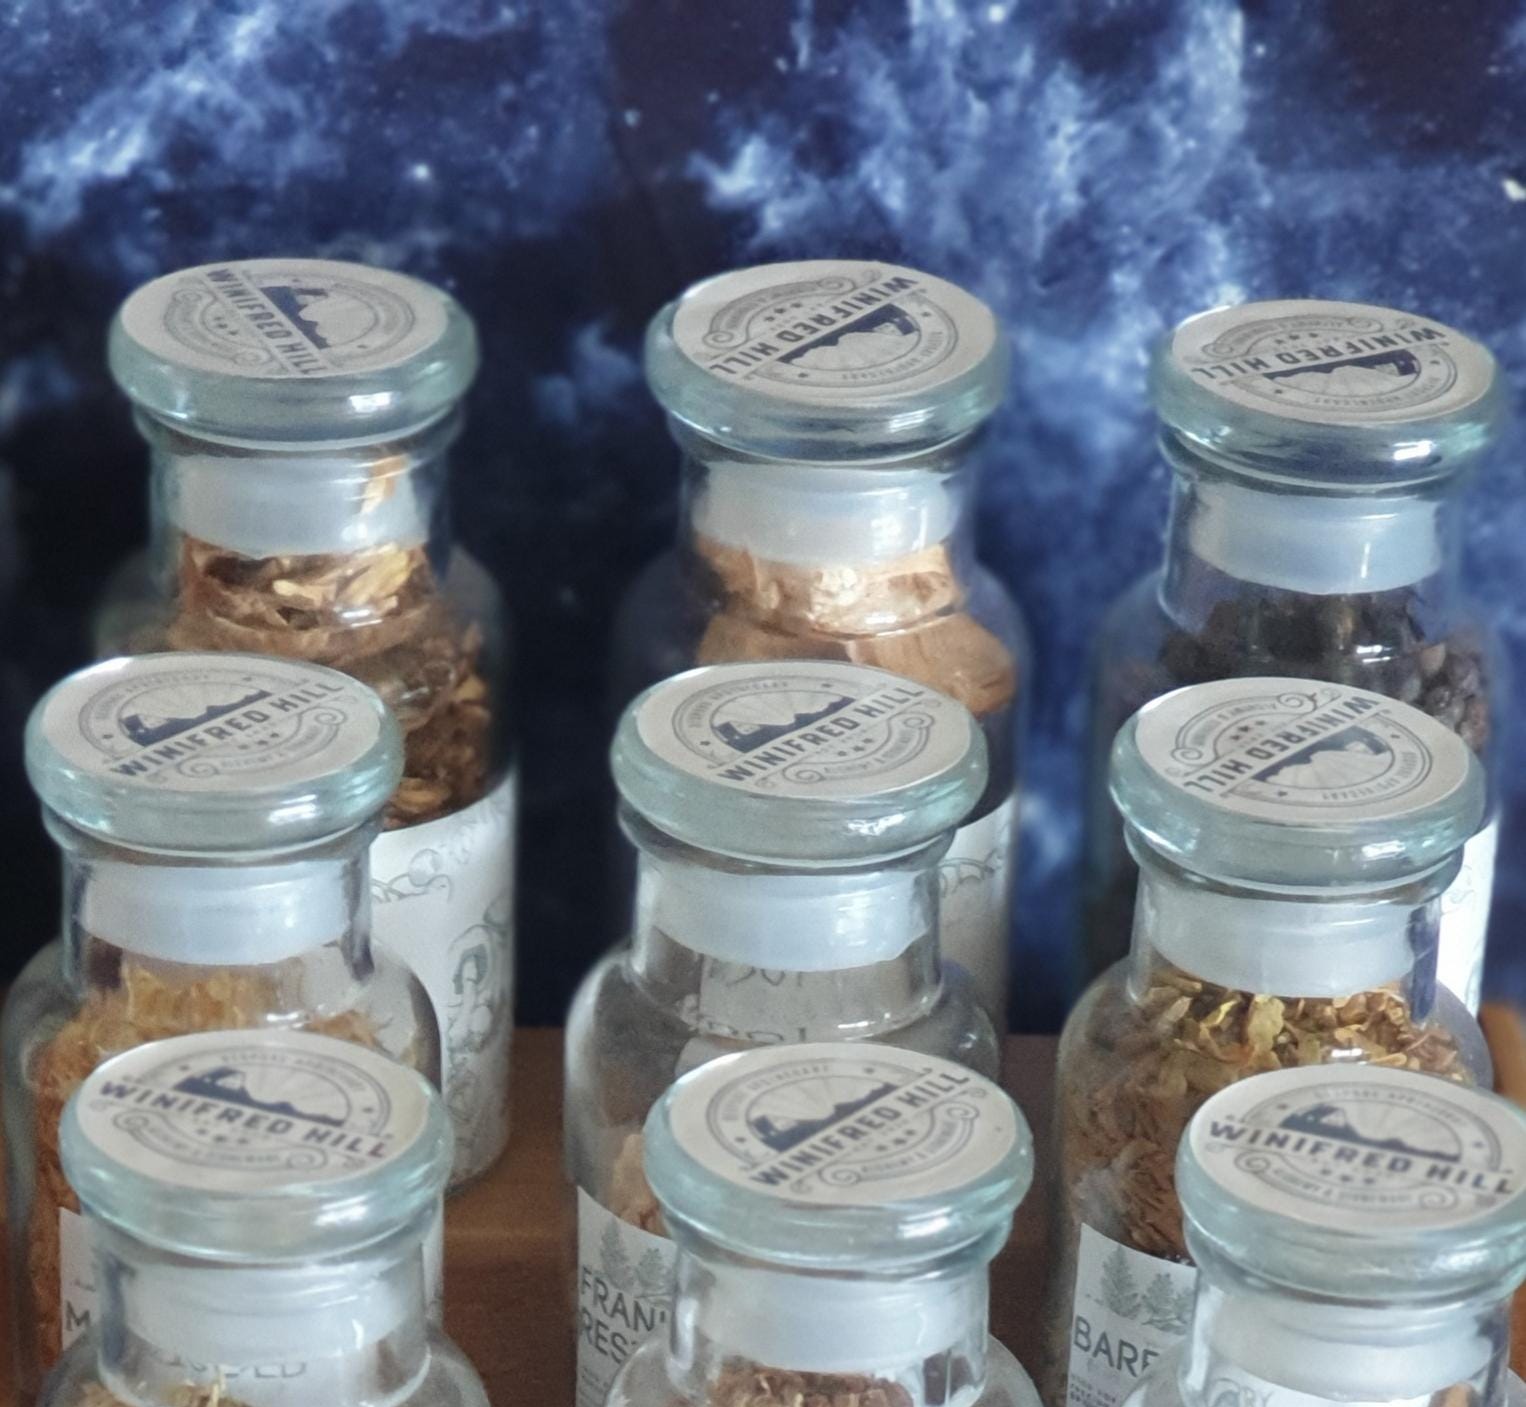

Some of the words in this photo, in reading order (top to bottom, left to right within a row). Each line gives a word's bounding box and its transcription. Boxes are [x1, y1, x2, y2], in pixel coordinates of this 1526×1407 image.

[205, 267, 292, 346] WINIFRED
[285, 348, 328, 374] HILL
[776, 276, 919, 344] WINIFRED
[708, 344, 779, 375] HILL
[1190, 355, 1271, 379] HILL
[1274, 326, 1447, 365] WINIFRED
[109, 711, 271, 777] WINIFRED
[269, 682, 345, 713] HILL
[717, 715, 862, 782] WINIFRED
[856, 686, 926, 719] HILL
[1248, 695, 1381, 763] WINIFRED
[1183, 761, 1254, 795] HILL
[99, 1080, 295, 1135] WINIFRED
[301, 1127, 388, 1160] HILL
[751, 1106, 902, 1187] WINIFRED
[899, 1072, 972, 1109] HILL
[1209, 1120, 1412, 1173] WINIFRED
[1425, 1164, 1516, 1195] HILL
[582, 1305, 637, 1364] RES
